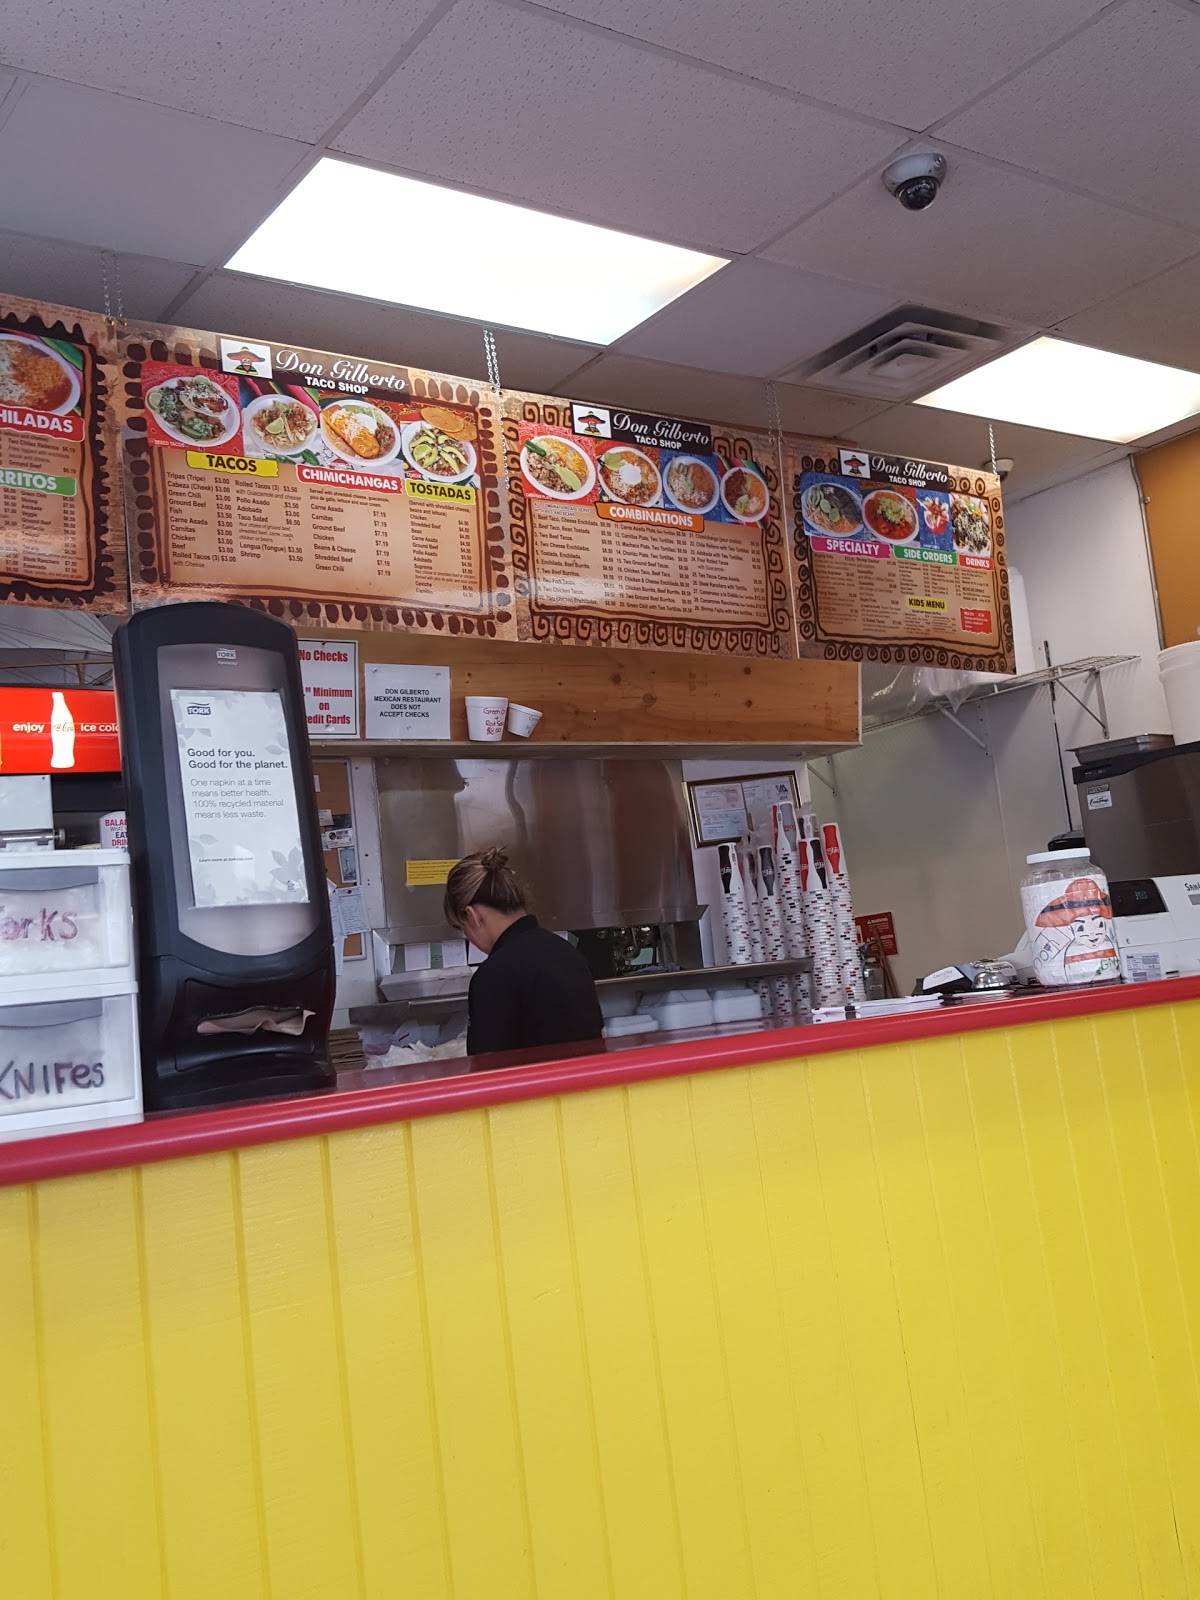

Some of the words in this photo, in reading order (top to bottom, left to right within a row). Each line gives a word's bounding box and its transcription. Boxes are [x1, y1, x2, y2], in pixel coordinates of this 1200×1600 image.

[276, 350, 324, 375] Don
[330, 360, 406, 391] Gilberto
[305, 376, 336, 389] TACO
[338, 382, 369, 395] SHOP
[613, 412, 649, 435] Don
[653, 420, 710, 446] Gilberto
[634, 434, 658, 447] TACO
[659, 439, 682, 450] SHOP
[206, 455, 257, 472] TACOS
[871, 456, 899, 475] Don
[903, 462, 948, 484] Gilberto
[302, 468, 399, 491] CHIMICHANGAS
[889, 475, 907, 484] TACO
[908, 479, 926, 488] SHOP
[410, 482, 471, 501] TOSTADAS
[169, 498, 192, 506] Ground
[236, 496, 251, 504] Pollo
[310, 503, 326, 511] Carne
[327, 505, 344, 513] Asada
[237, 513, 251, 521] Taco
[311, 513, 333, 522] Carnitas
[609, 506, 693, 528] COMBINATIONS
[170, 525, 196, 533] Carnitas
[312, 523, 332, 532] Ground
[333, 525, 346, 533] Beef
[171, 533, 196, 541] Chicken
[239, 542, 261, 551] Lengua
[313, 543, 331, 551] Beans
[826, 539, 880, 555] SPECIALTY
[172, 551, 192, 559] Rolled
[240, 550, 261, 559] Shrimp
[904, 548, 921, 559] SIDE
[922, 551, 953, 564] ORDERS
[965, 557, 990, 568] DRINKS
[908, 598, 925, 607] KIDS
[926, 601, 945, 609] MENU
[216, 650, 236, 659] TORK
[296, 650, 311, 661] No
[313, 650, 348, 662] Checks
[313, 687, 353, 698] Minimum
[402, 696, 442, 704] RESTAURANT
[187, 705, 211, 715] TORK
[319, 702, 330, 710] on
[326, 714, 351, 724] Cards
[12, 723, 45, 734] enjoy
[80, 723, 97, 732] ice
[187, 748, 215, 757] Good
[218, 748, 232, 757] for
[234, 749, 256, 759] you.
[188, 760, 217, 769] Good
[219, 760, 233, 769] for
[236, 760, 252, 769] the
[254, 760, 288, 770] planet.
[190, 779, 208, 787] One
[209, 779, 235, 788] napkin
[254, 778, 271, 786] time
[220, 789, 244, 797] better
[218, 799, 252, 809] recycled
[253, 799, 284, 807] material
[194, 811, 221, 819] means
[223, 811, 239, 819] less
[0, 905, 78, 941] orKS
